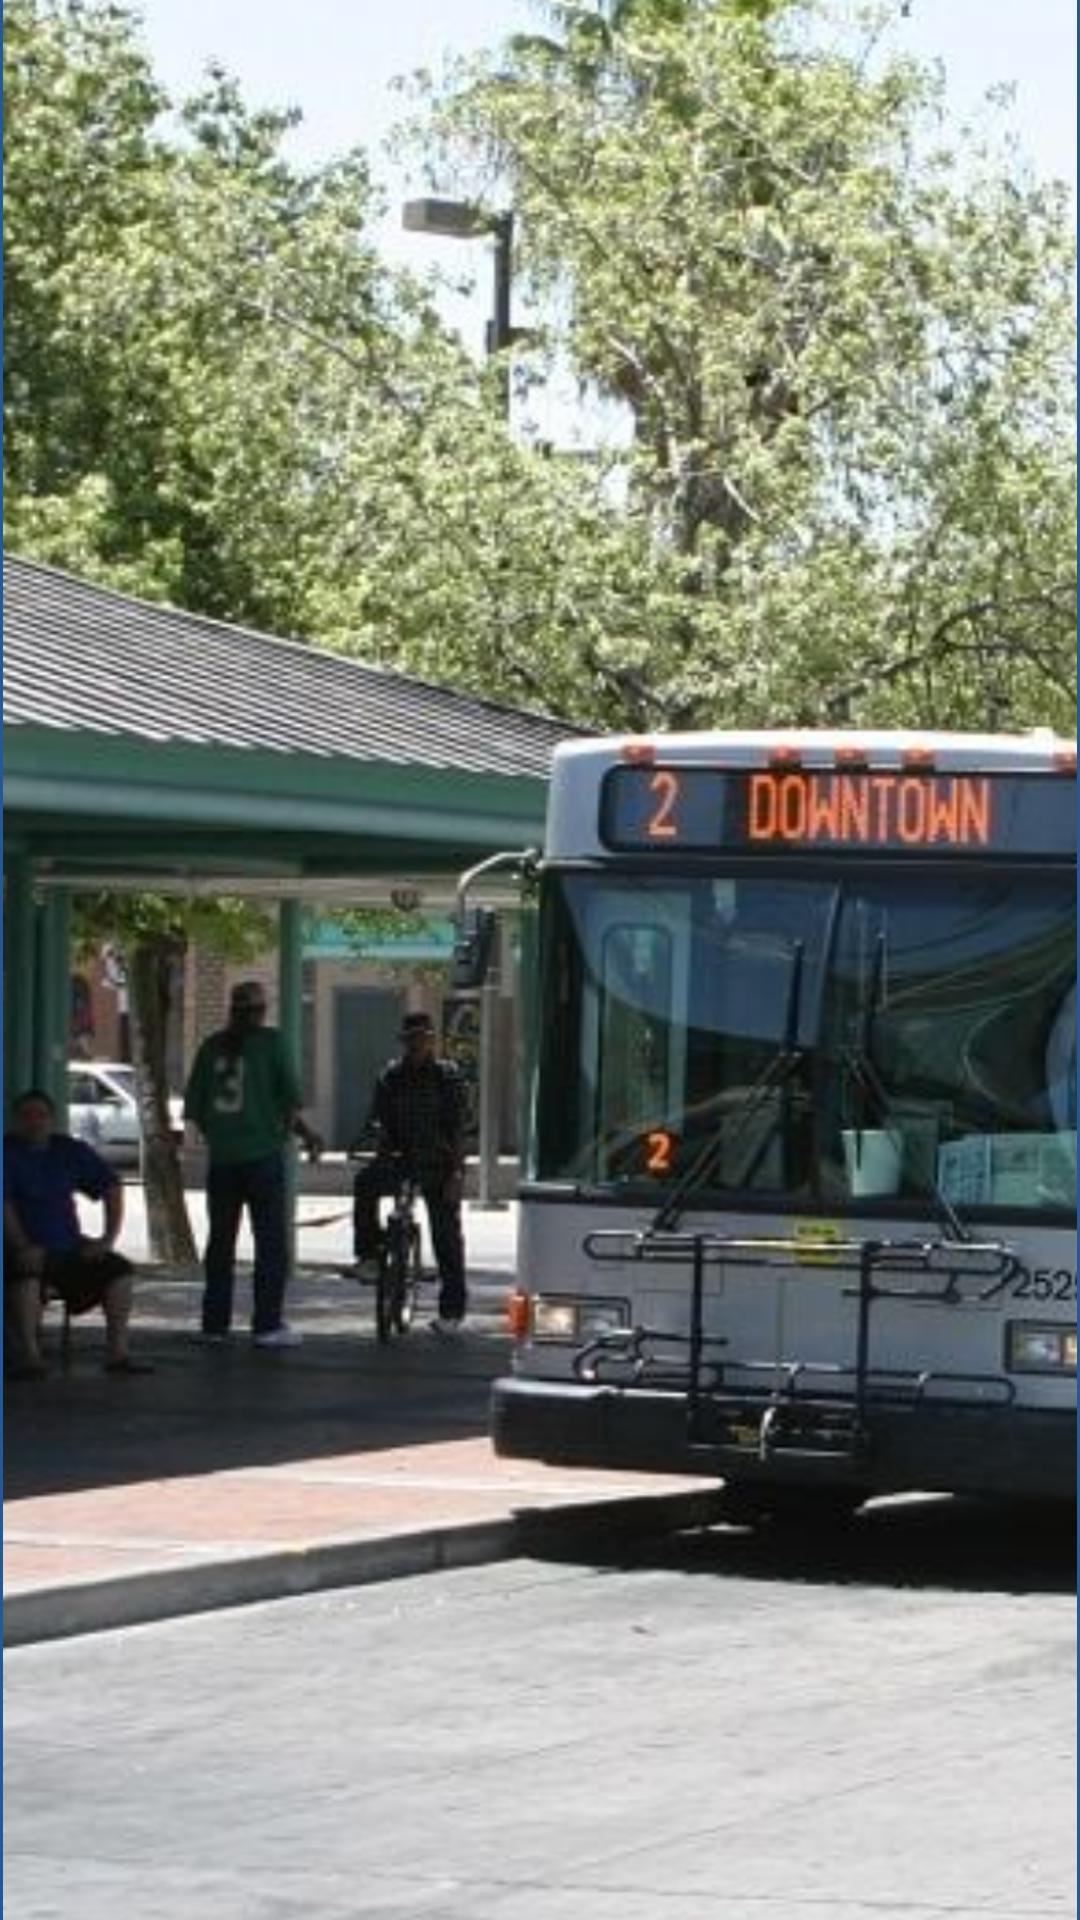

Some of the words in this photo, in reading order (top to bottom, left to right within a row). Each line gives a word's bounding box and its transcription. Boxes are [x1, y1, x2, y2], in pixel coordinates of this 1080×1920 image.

[648, 771, 678, 836] 2
[749, 774, 990, 844] DOWNTOWN
[213, 1055, 245, 1113] 3
[647, 1131, 670, 1169] 2
[1012, 1267, 1077, 1301] 252
